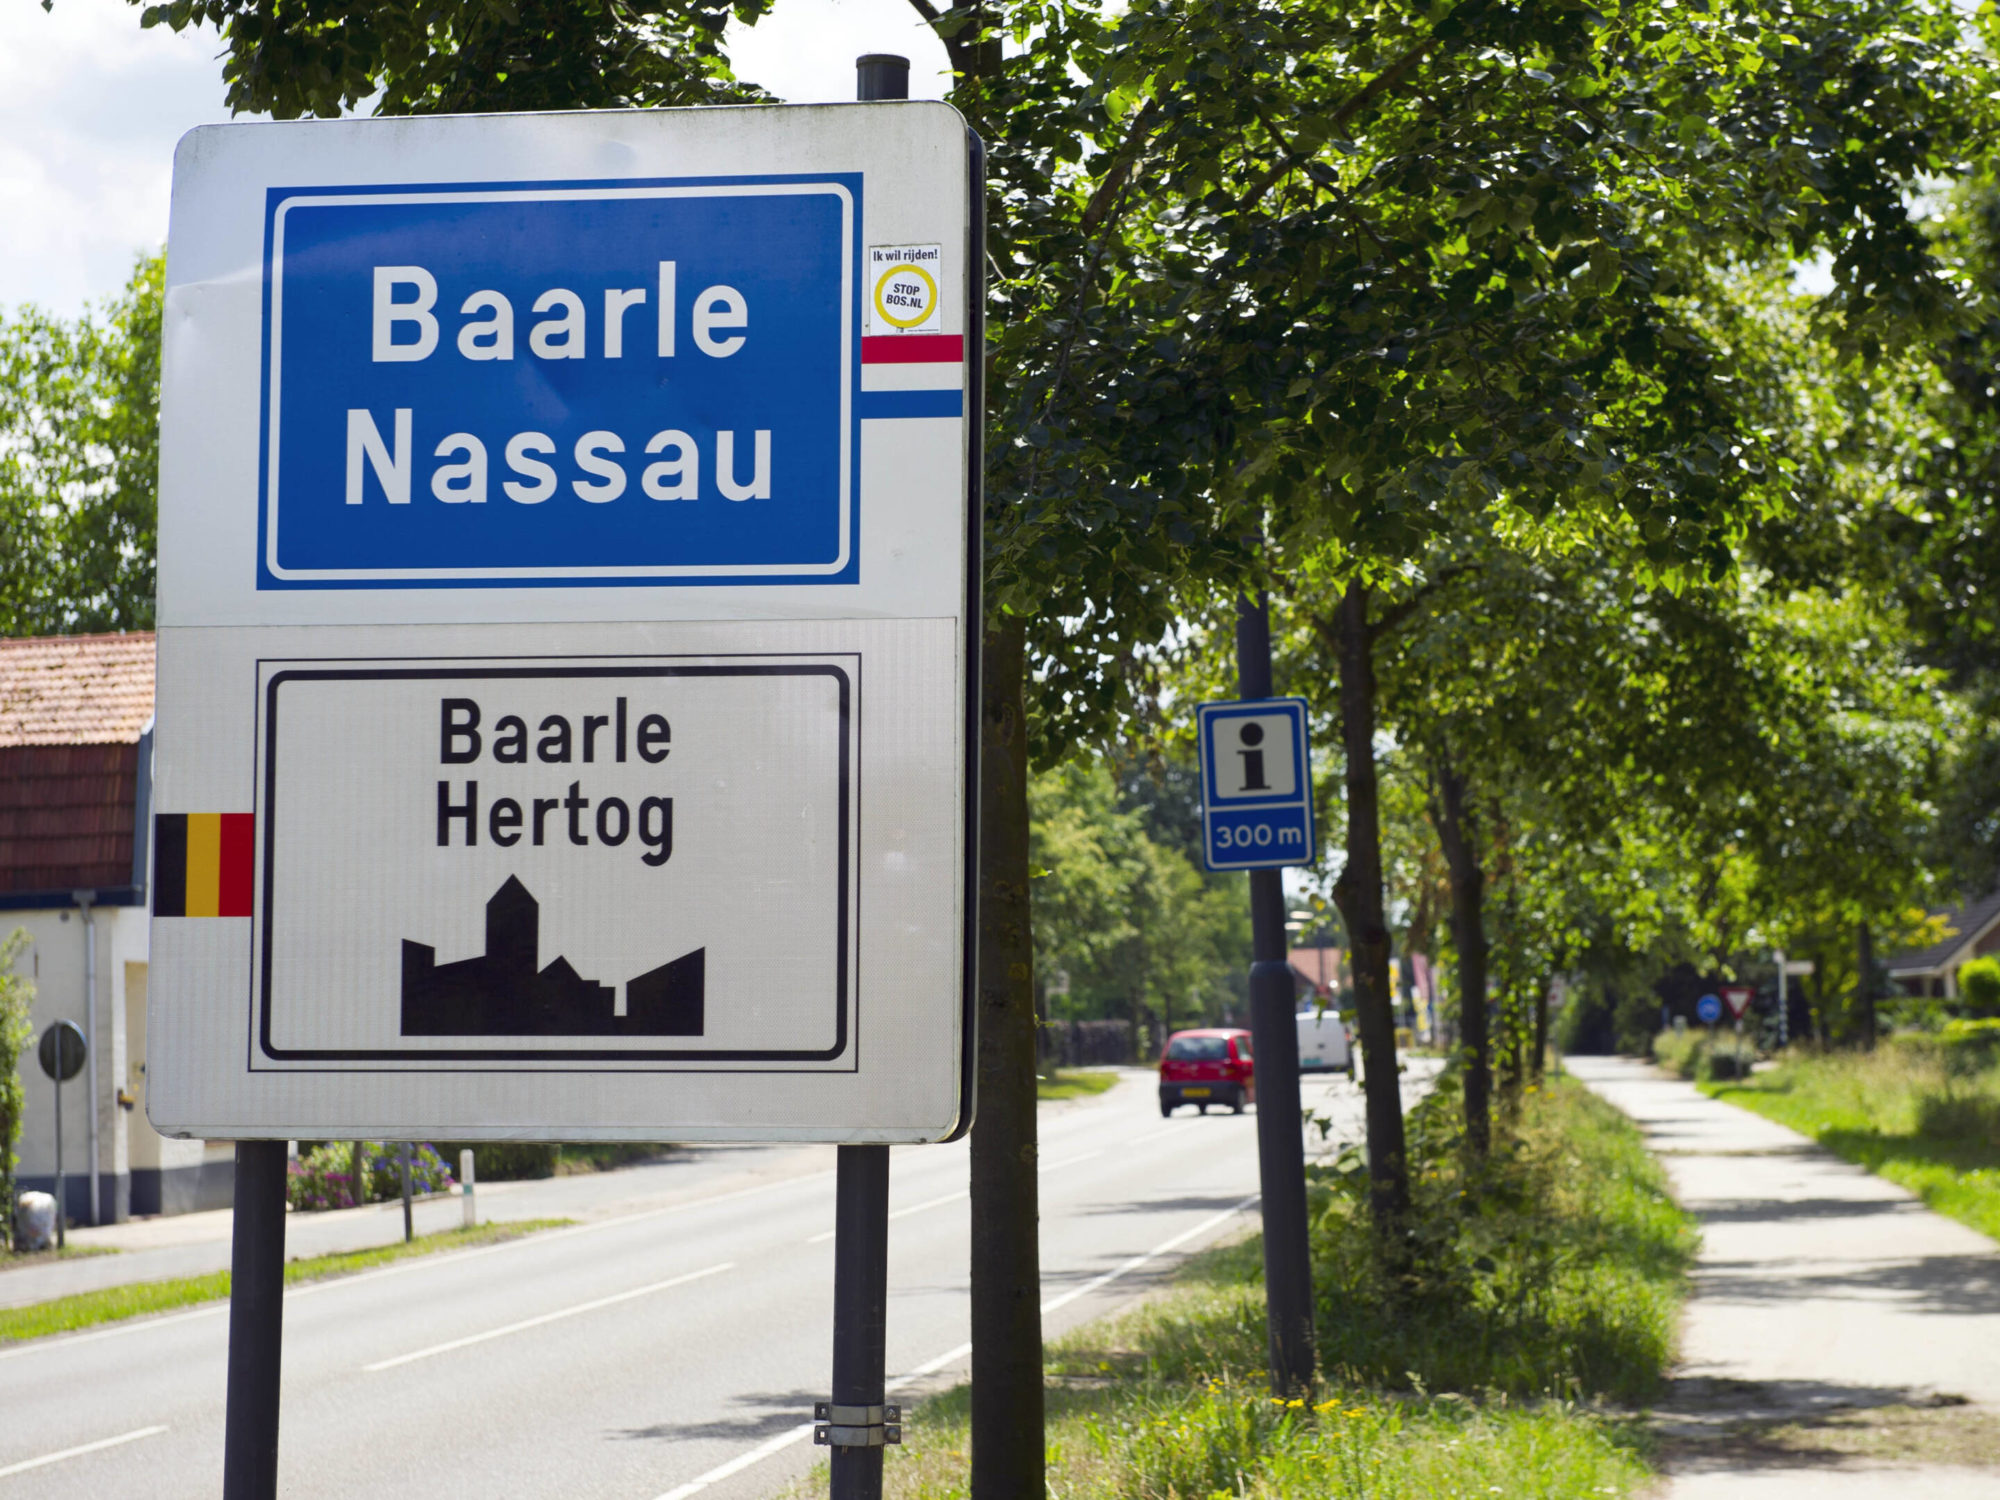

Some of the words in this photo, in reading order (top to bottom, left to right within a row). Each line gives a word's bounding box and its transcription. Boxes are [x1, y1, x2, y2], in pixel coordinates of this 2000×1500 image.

[873, 250, 883, 262] Ik
[885, 250, 901, 261] wil
[903, 248, 938, 263] rijden!
[372, 260, 748, 363] Baarle
[886, 294, 923, 309] BOS.NL
[893, 283, 920, 296] STOP
[345, 408, 772, 505] Nassau
[440, 696, 671, 765] Baarle
[436, 780, 673, 867] Hertog
[1216, 823, 1273, 849] 300
[1277, 825, 1303, 845] m
